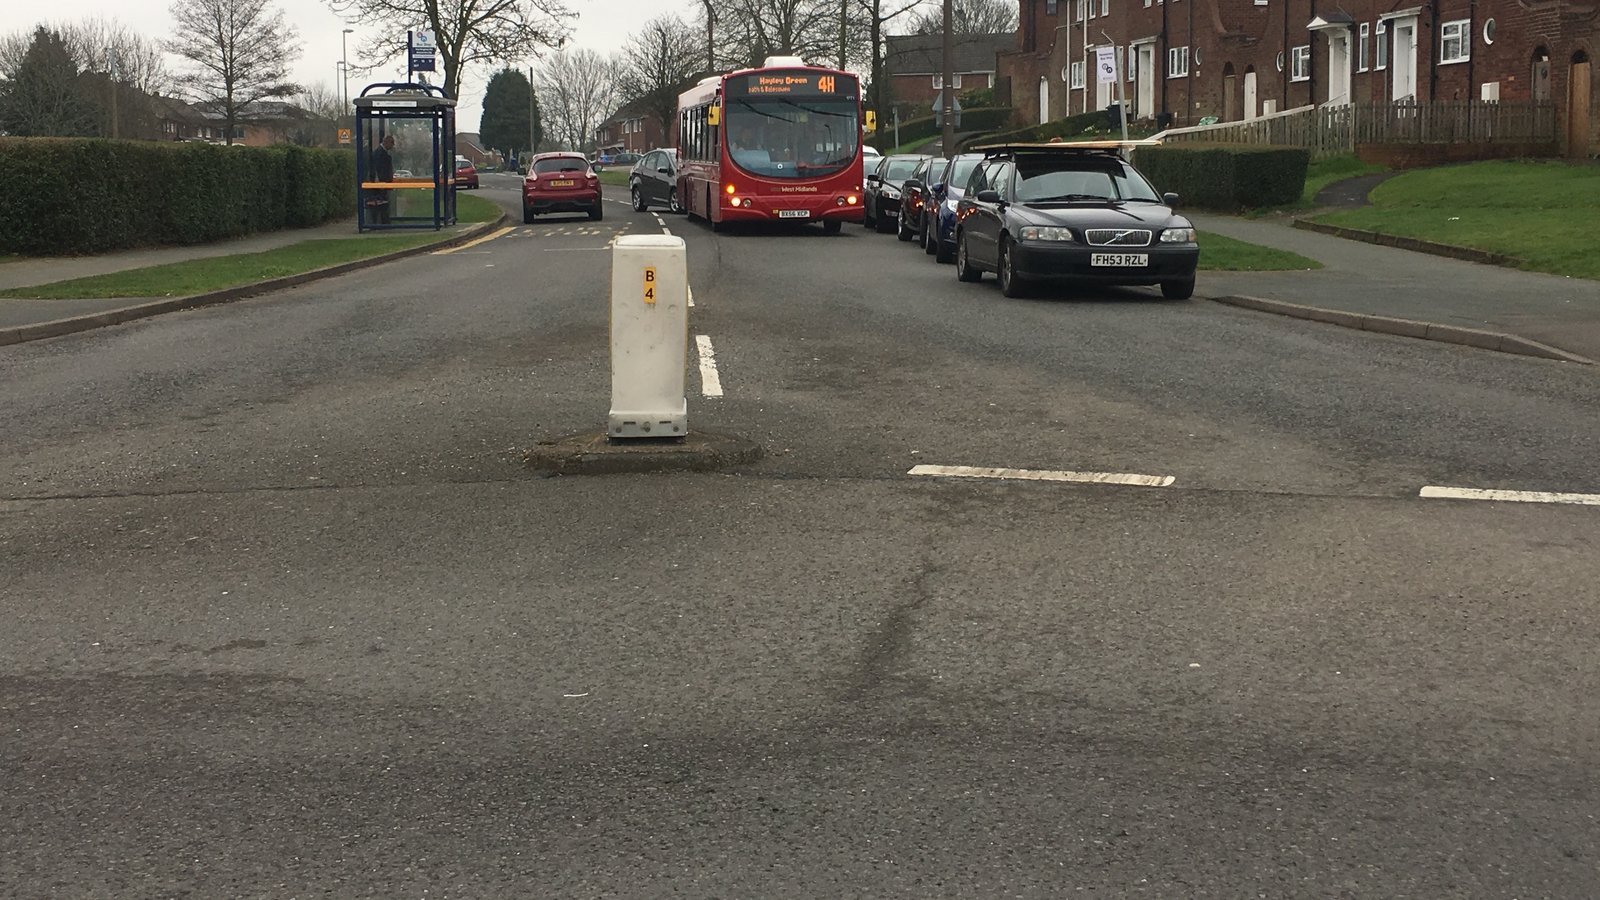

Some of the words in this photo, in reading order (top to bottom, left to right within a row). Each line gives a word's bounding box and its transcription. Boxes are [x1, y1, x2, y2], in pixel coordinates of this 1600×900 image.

[759, 76, 784, 85] Hayley
[785, 76, 808, 85] Green
[818, 76, 835, 93] 4H
[1095, 255, 1122, 265] FH53
[1124, 255, 1144, 265] RZL
[646, 270, 654, 282] B
[645, 287, 654, 300] 4
